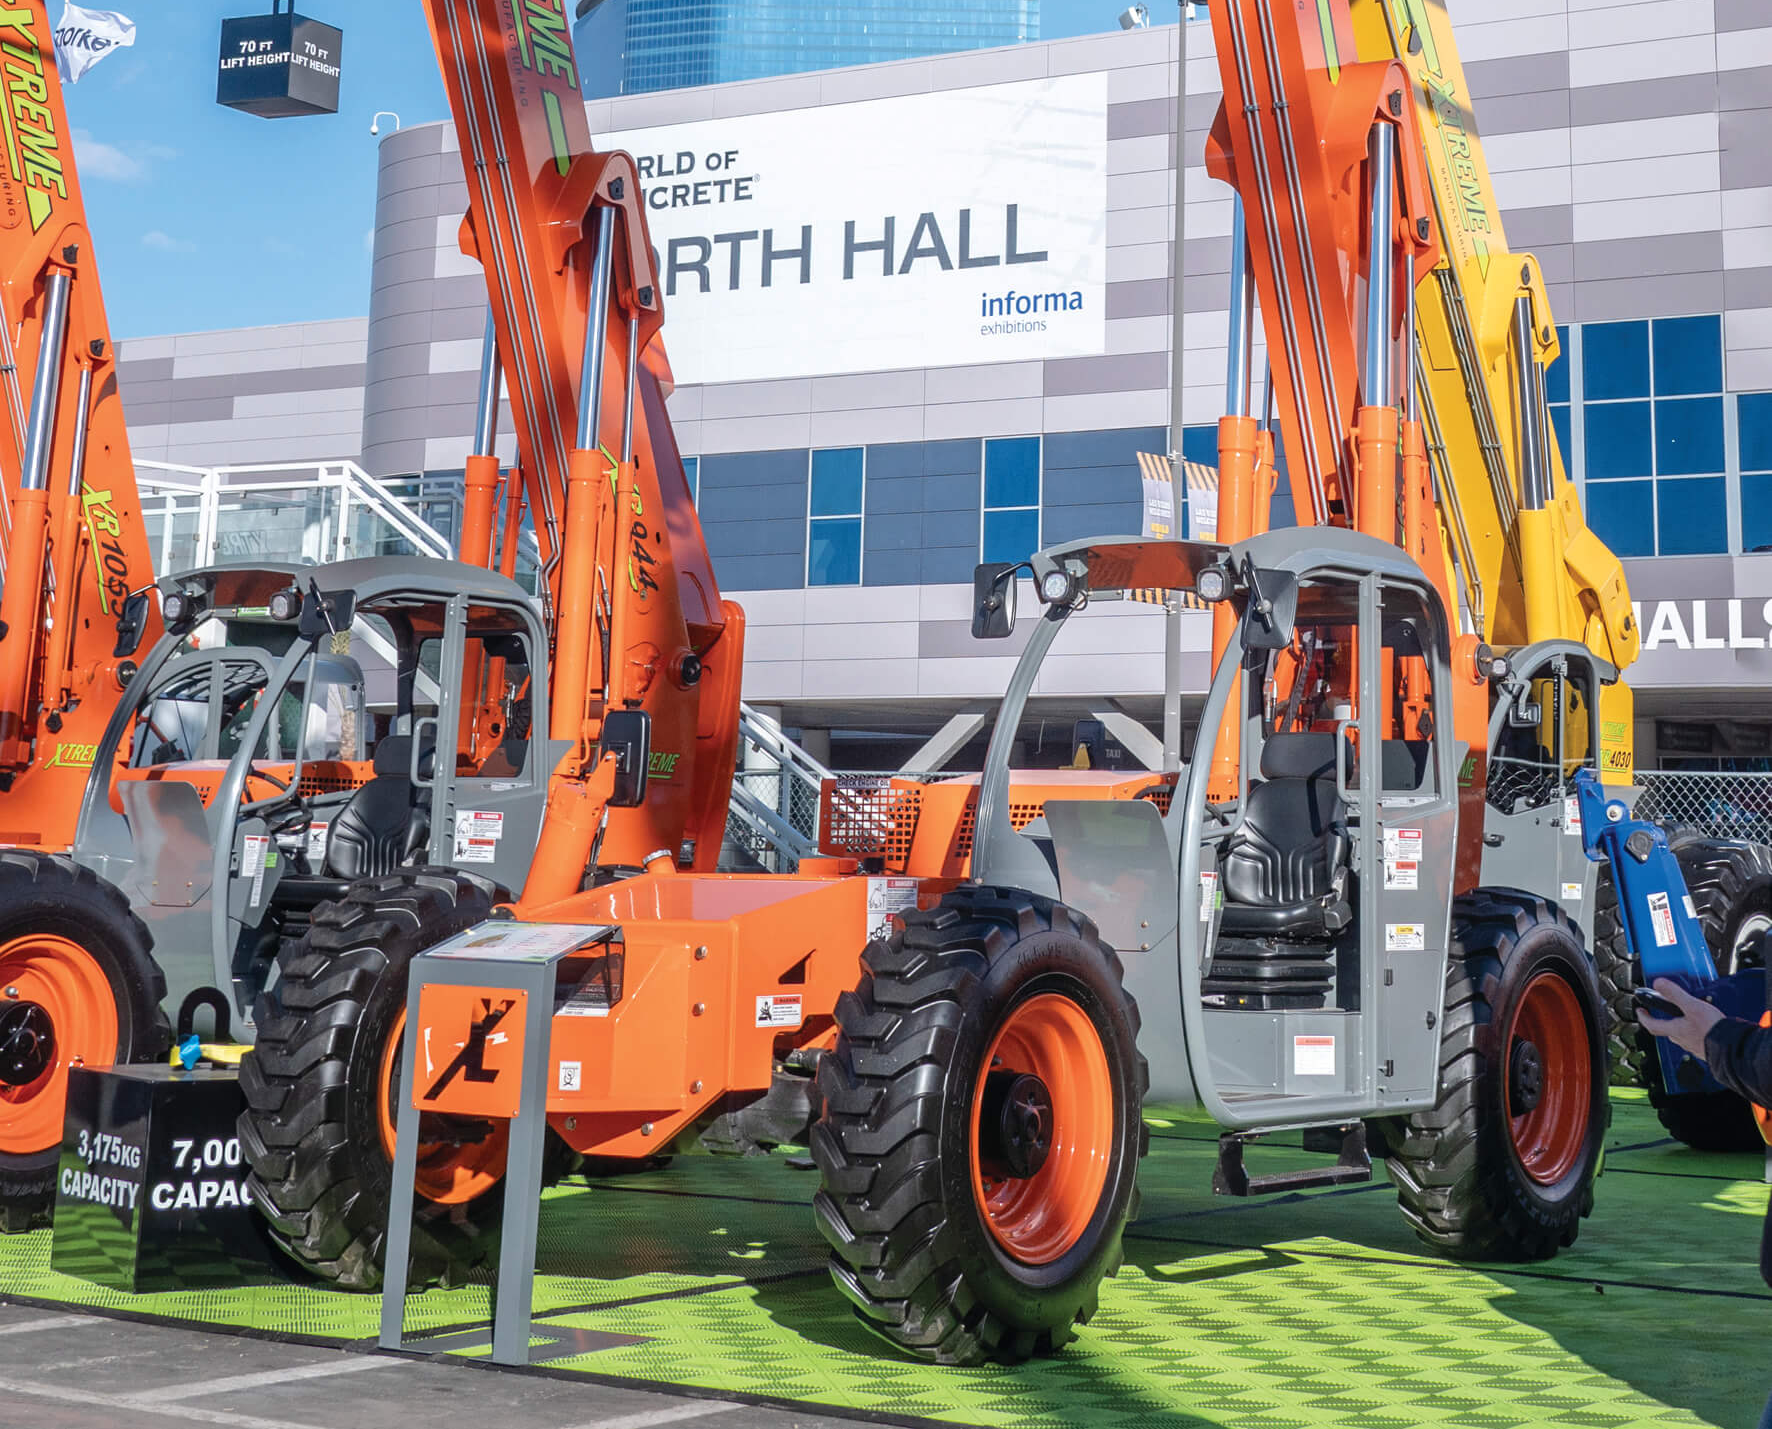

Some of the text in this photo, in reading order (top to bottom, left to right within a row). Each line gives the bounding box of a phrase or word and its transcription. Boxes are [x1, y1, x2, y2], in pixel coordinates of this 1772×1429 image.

[220, 52, 290, 69] LIFT HEIGHT
[240, 40, 273, 53] 70 FT
[304, 41, 329, 60] 70 FT
[291, 52, 340, 77] LIFT HEIGHT
[637, 150, 739, 179] RLD OF
[1418, 69, 1491, 234] XTREME
[643, 176, 754, 212] CRETE
[653, 203, 1049, 296] RTH HALL
[981, 290, 1083, 317] informa
[980, 318, 1047, 336] exhibitions
[1633, 598, 1772, 651] ALL
[44, 742, 98, 770] XTREM
[172, 1138, 241, 1174] 7,00
[61, 1168, 139, 1209] CAPACITY
[152, 1179, 253, 1210] CAPAC
